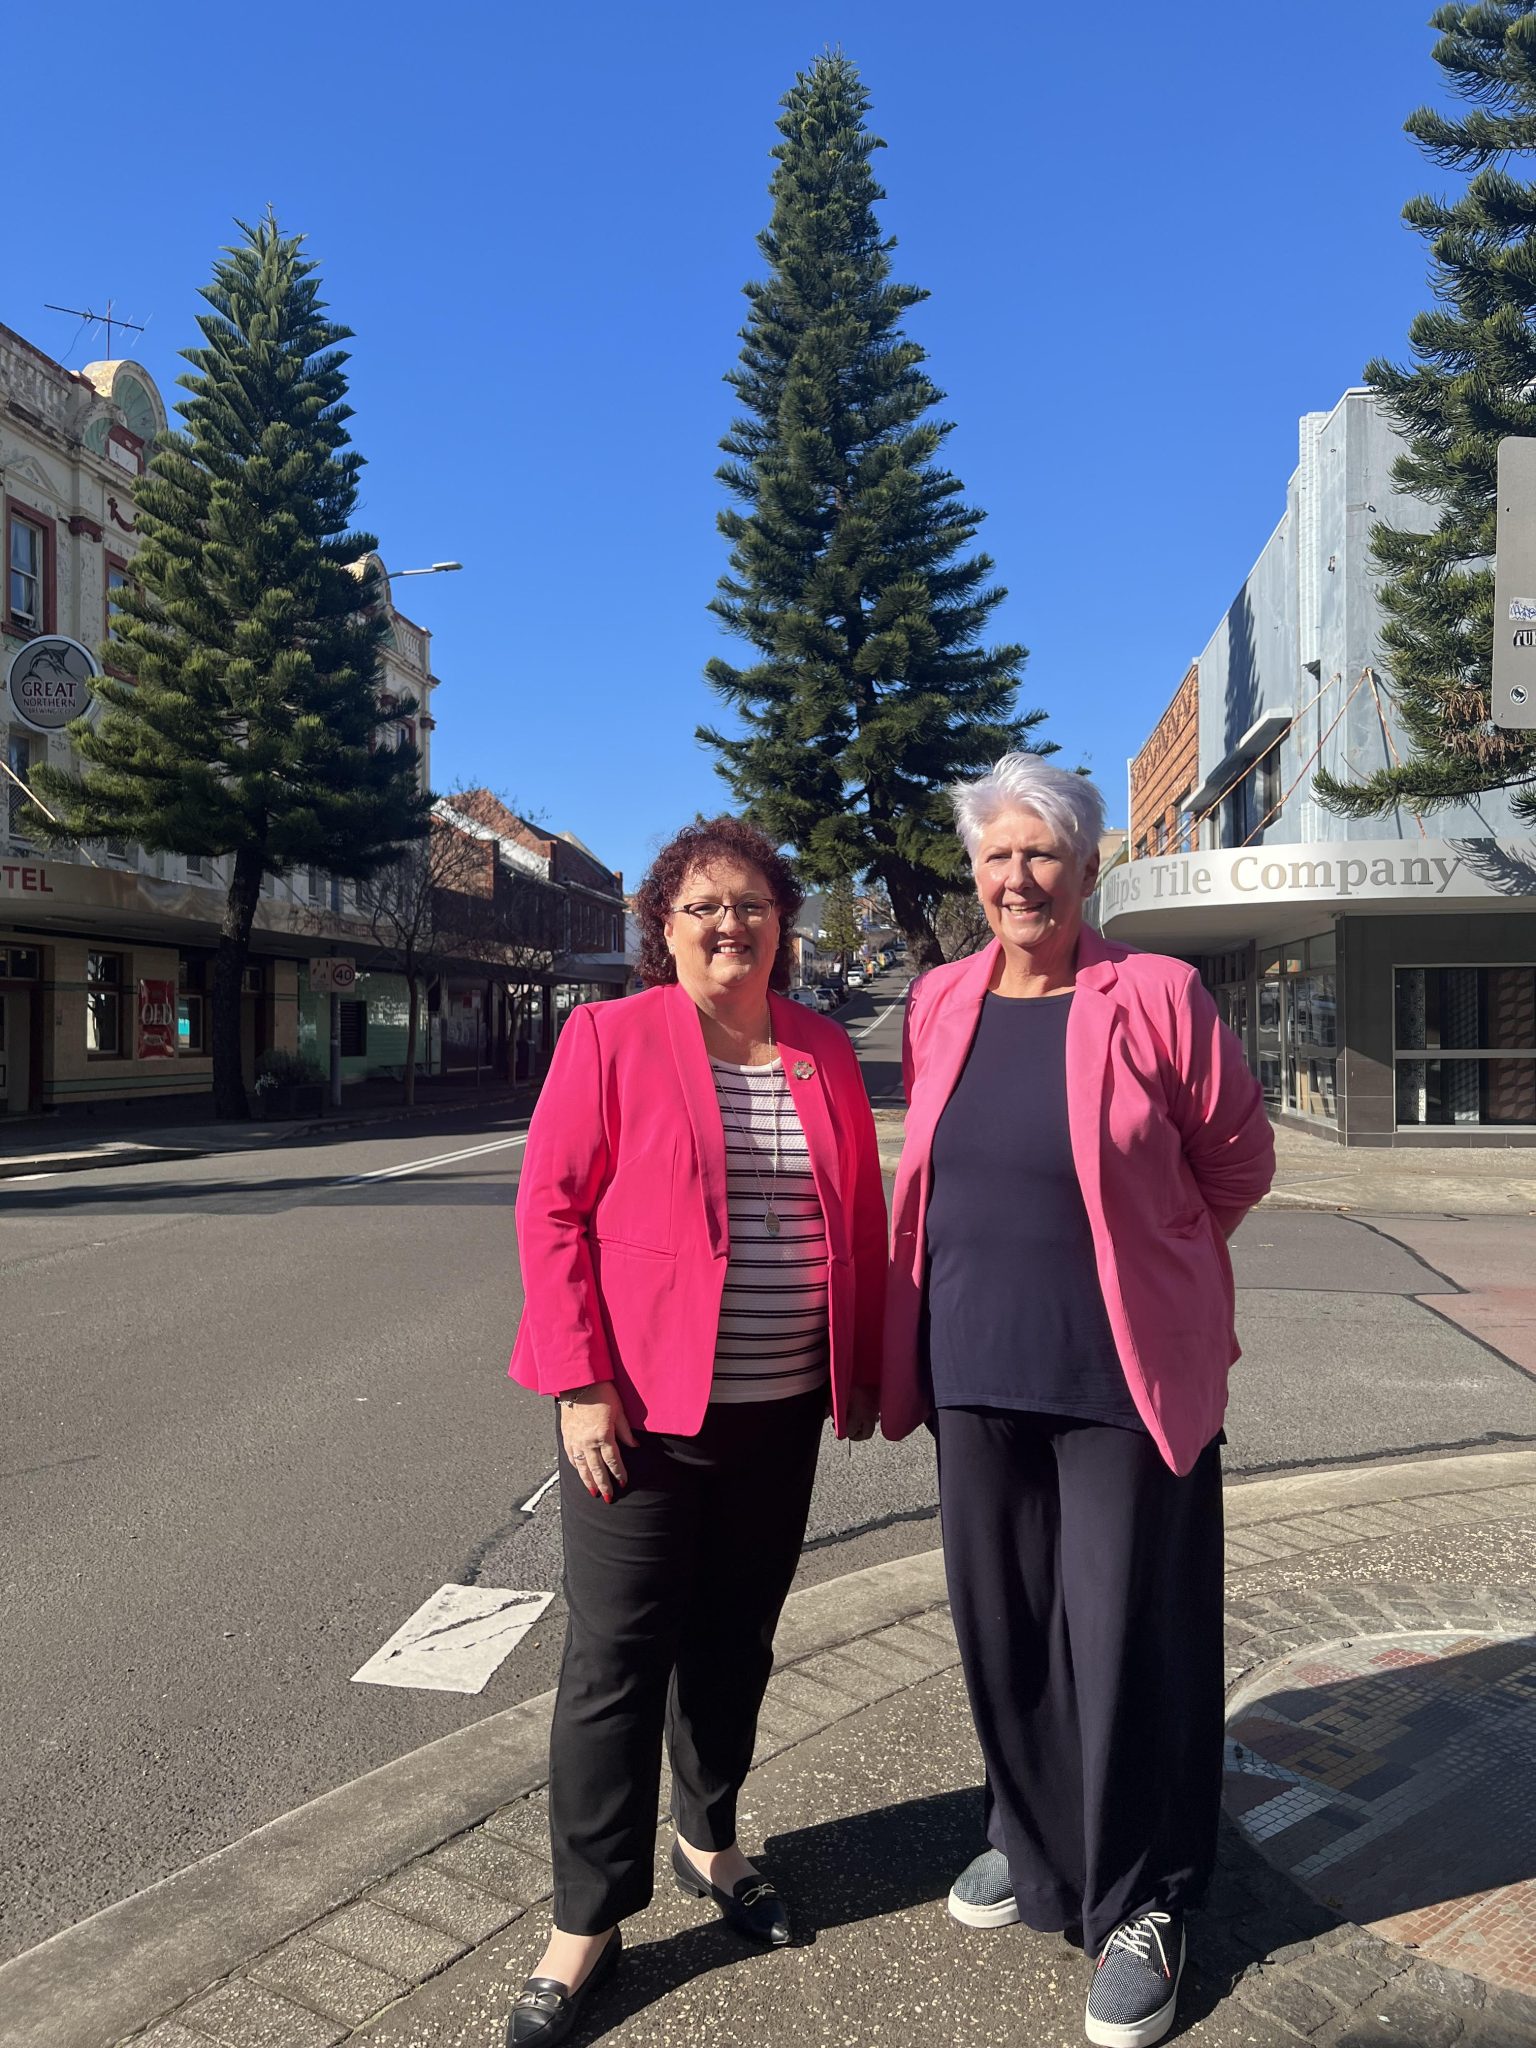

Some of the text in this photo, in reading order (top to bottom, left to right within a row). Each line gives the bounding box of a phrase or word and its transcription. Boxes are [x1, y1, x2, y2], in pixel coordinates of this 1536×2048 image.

[21, 681, 77, 698] GREAT
[23, 697, 76, 708] NORTHERN
[0, 865, 54, 892] TEL
[1150, 860, 1212, 898] Tile
[1230, 856, 1464, 895] Company
[336, 968, 352, 981] 40
[141, 1003, 173, 1026] OLD
